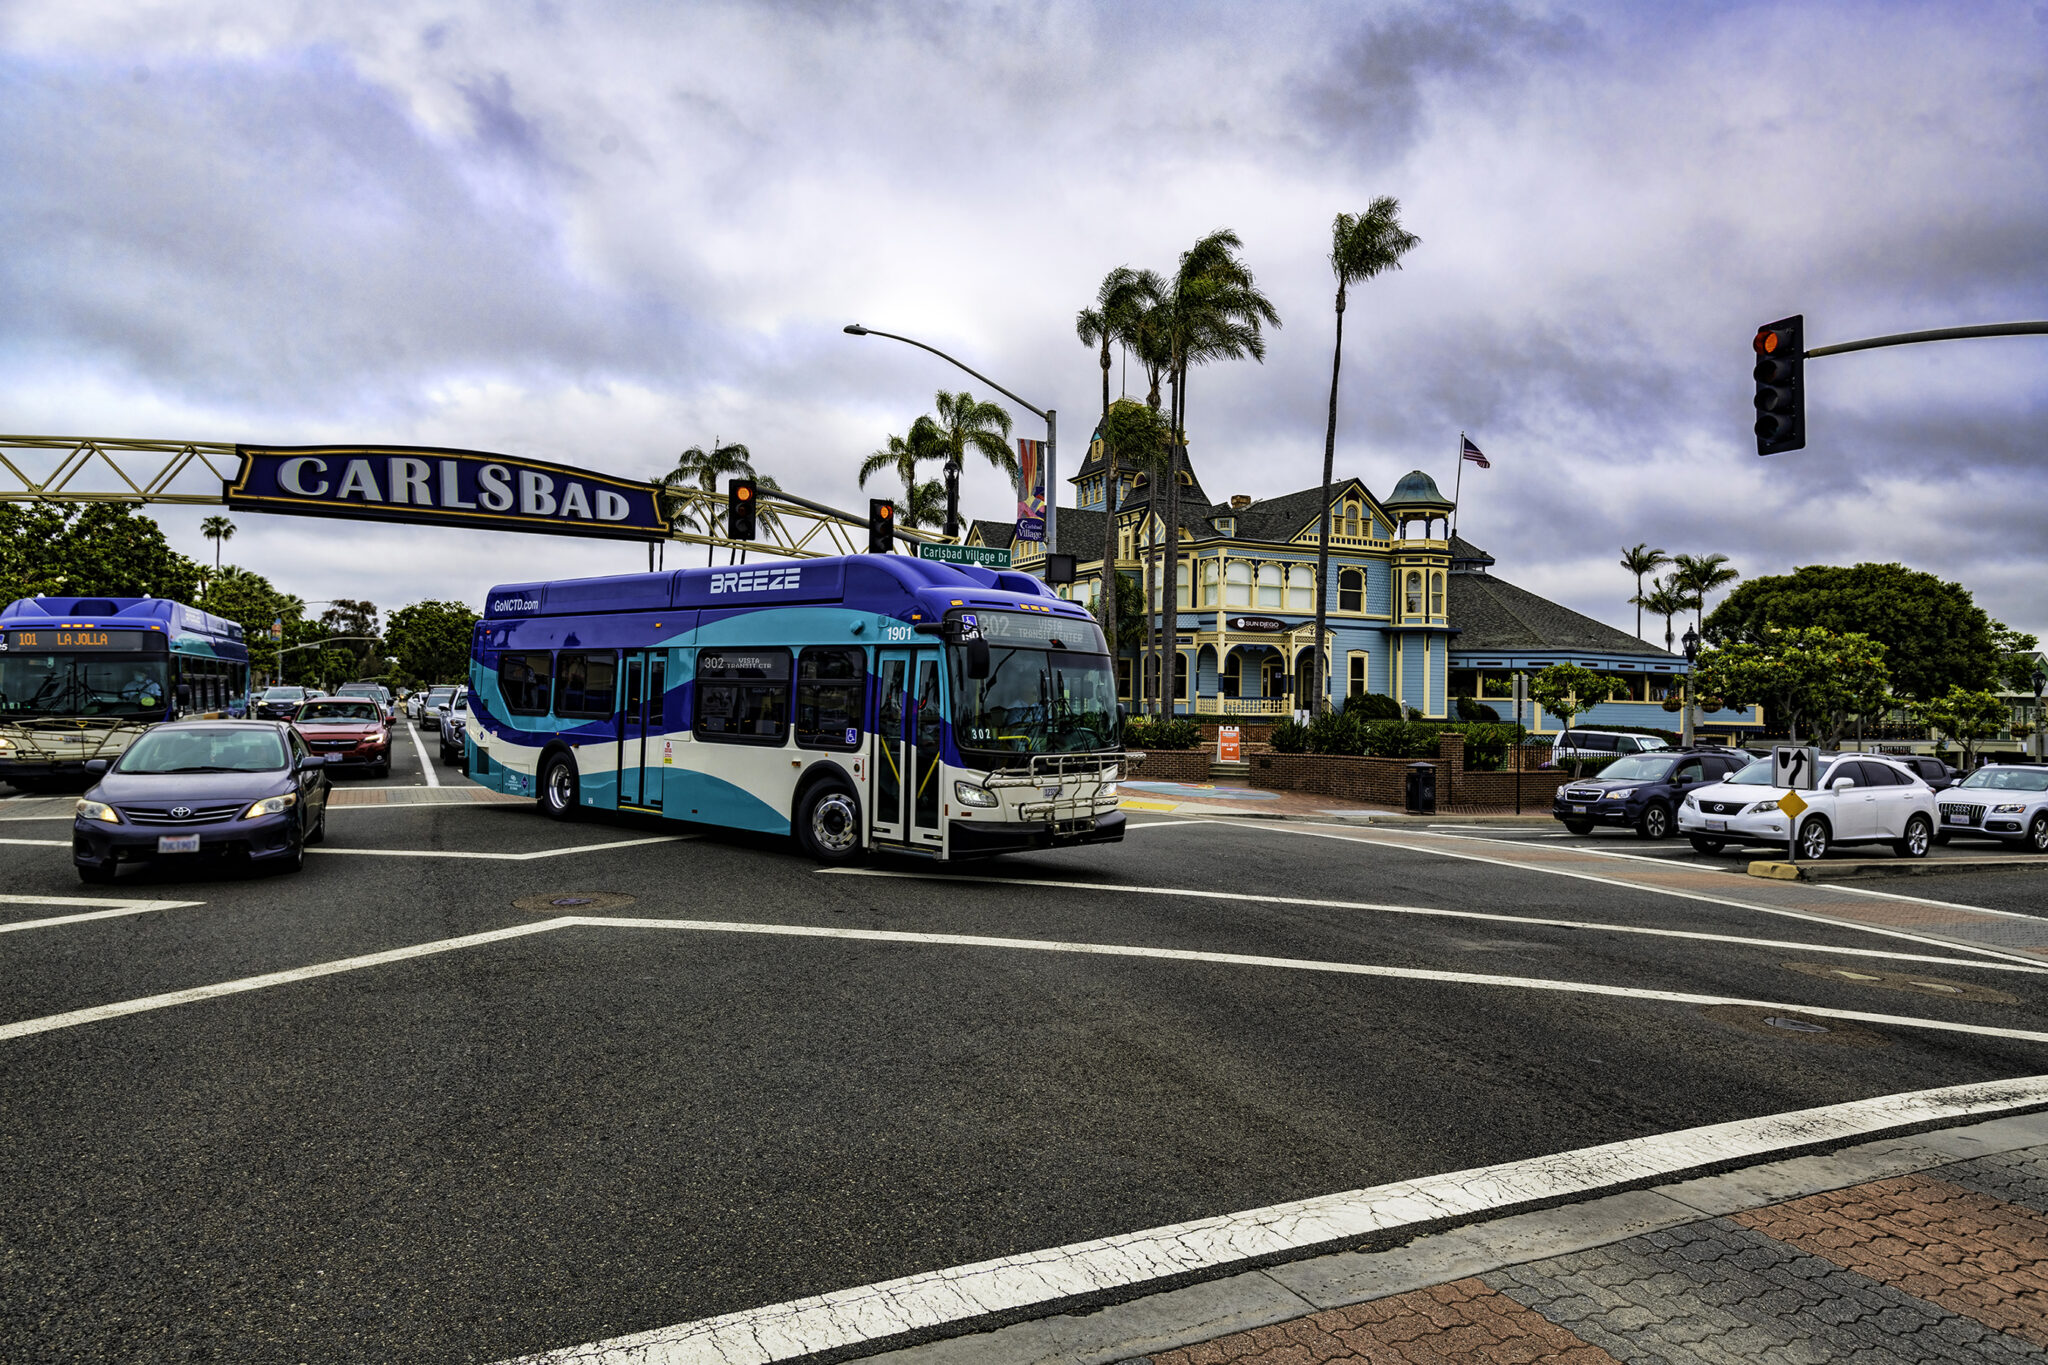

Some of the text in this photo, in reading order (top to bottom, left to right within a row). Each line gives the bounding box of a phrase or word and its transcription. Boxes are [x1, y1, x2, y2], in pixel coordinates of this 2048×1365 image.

[276, 457, 631, 522] CARLSBAD
[1018, 529, 1042, 540] Village
[923, 547, 1008, 564] Carlsbad Village Dr
[710, 567, 801, 594] BREEZE
[494, 598, 539, 612] GoNCTD.com
[979, 614, 1011, 637] 302
[1038, 618, 1063, 631] VISTA
[19, 632, 108, 646] 101 LA JOLLA
[887, 626, 912, 641] 1901
[1019, 628, 1084, 643] TRANSIT CENTER
[704, 657, 724, 669] 302
[972, 728, 991, 740] 302
